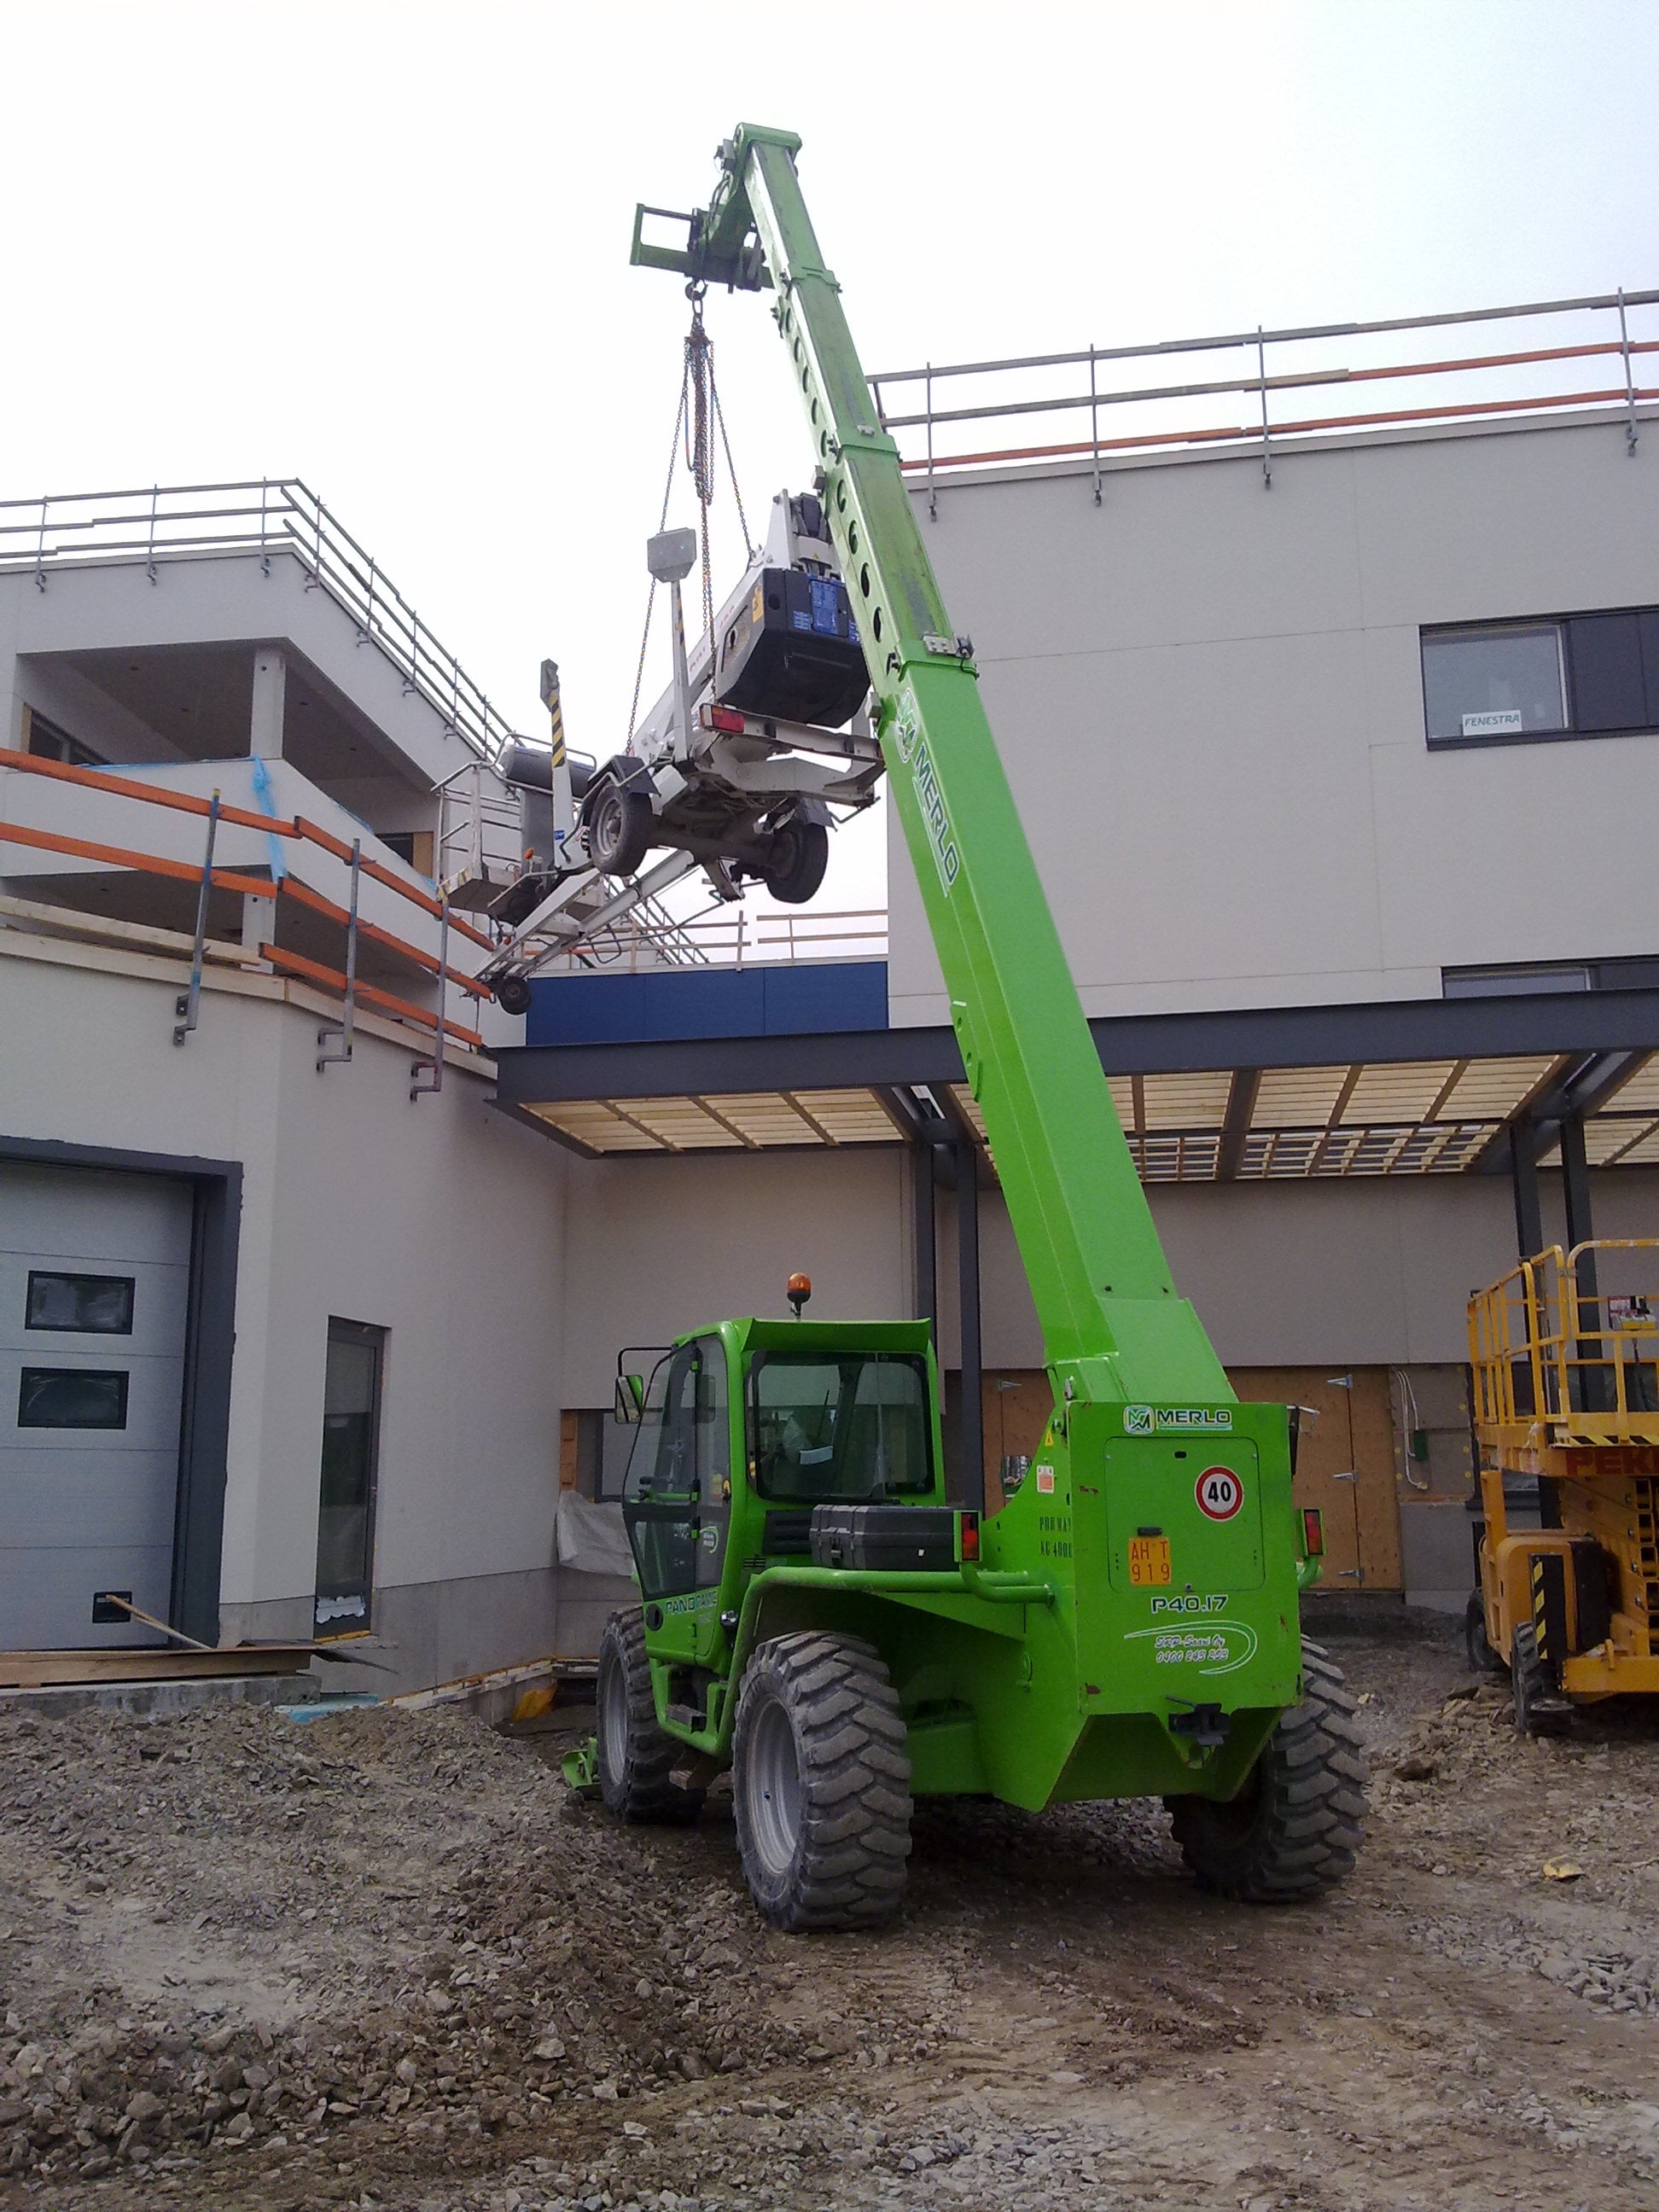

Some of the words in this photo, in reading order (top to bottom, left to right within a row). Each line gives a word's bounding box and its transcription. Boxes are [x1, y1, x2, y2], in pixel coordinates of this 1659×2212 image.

[1464, 713, 1520, 727] FENESTRA
[915, 741, 959, 885] MERLO
[1155, 1409, 1231, 1424] MERLO
[1208, 1481, 1231, 1503] 40
[1151, 1595, 1228, 1614] P40.17
